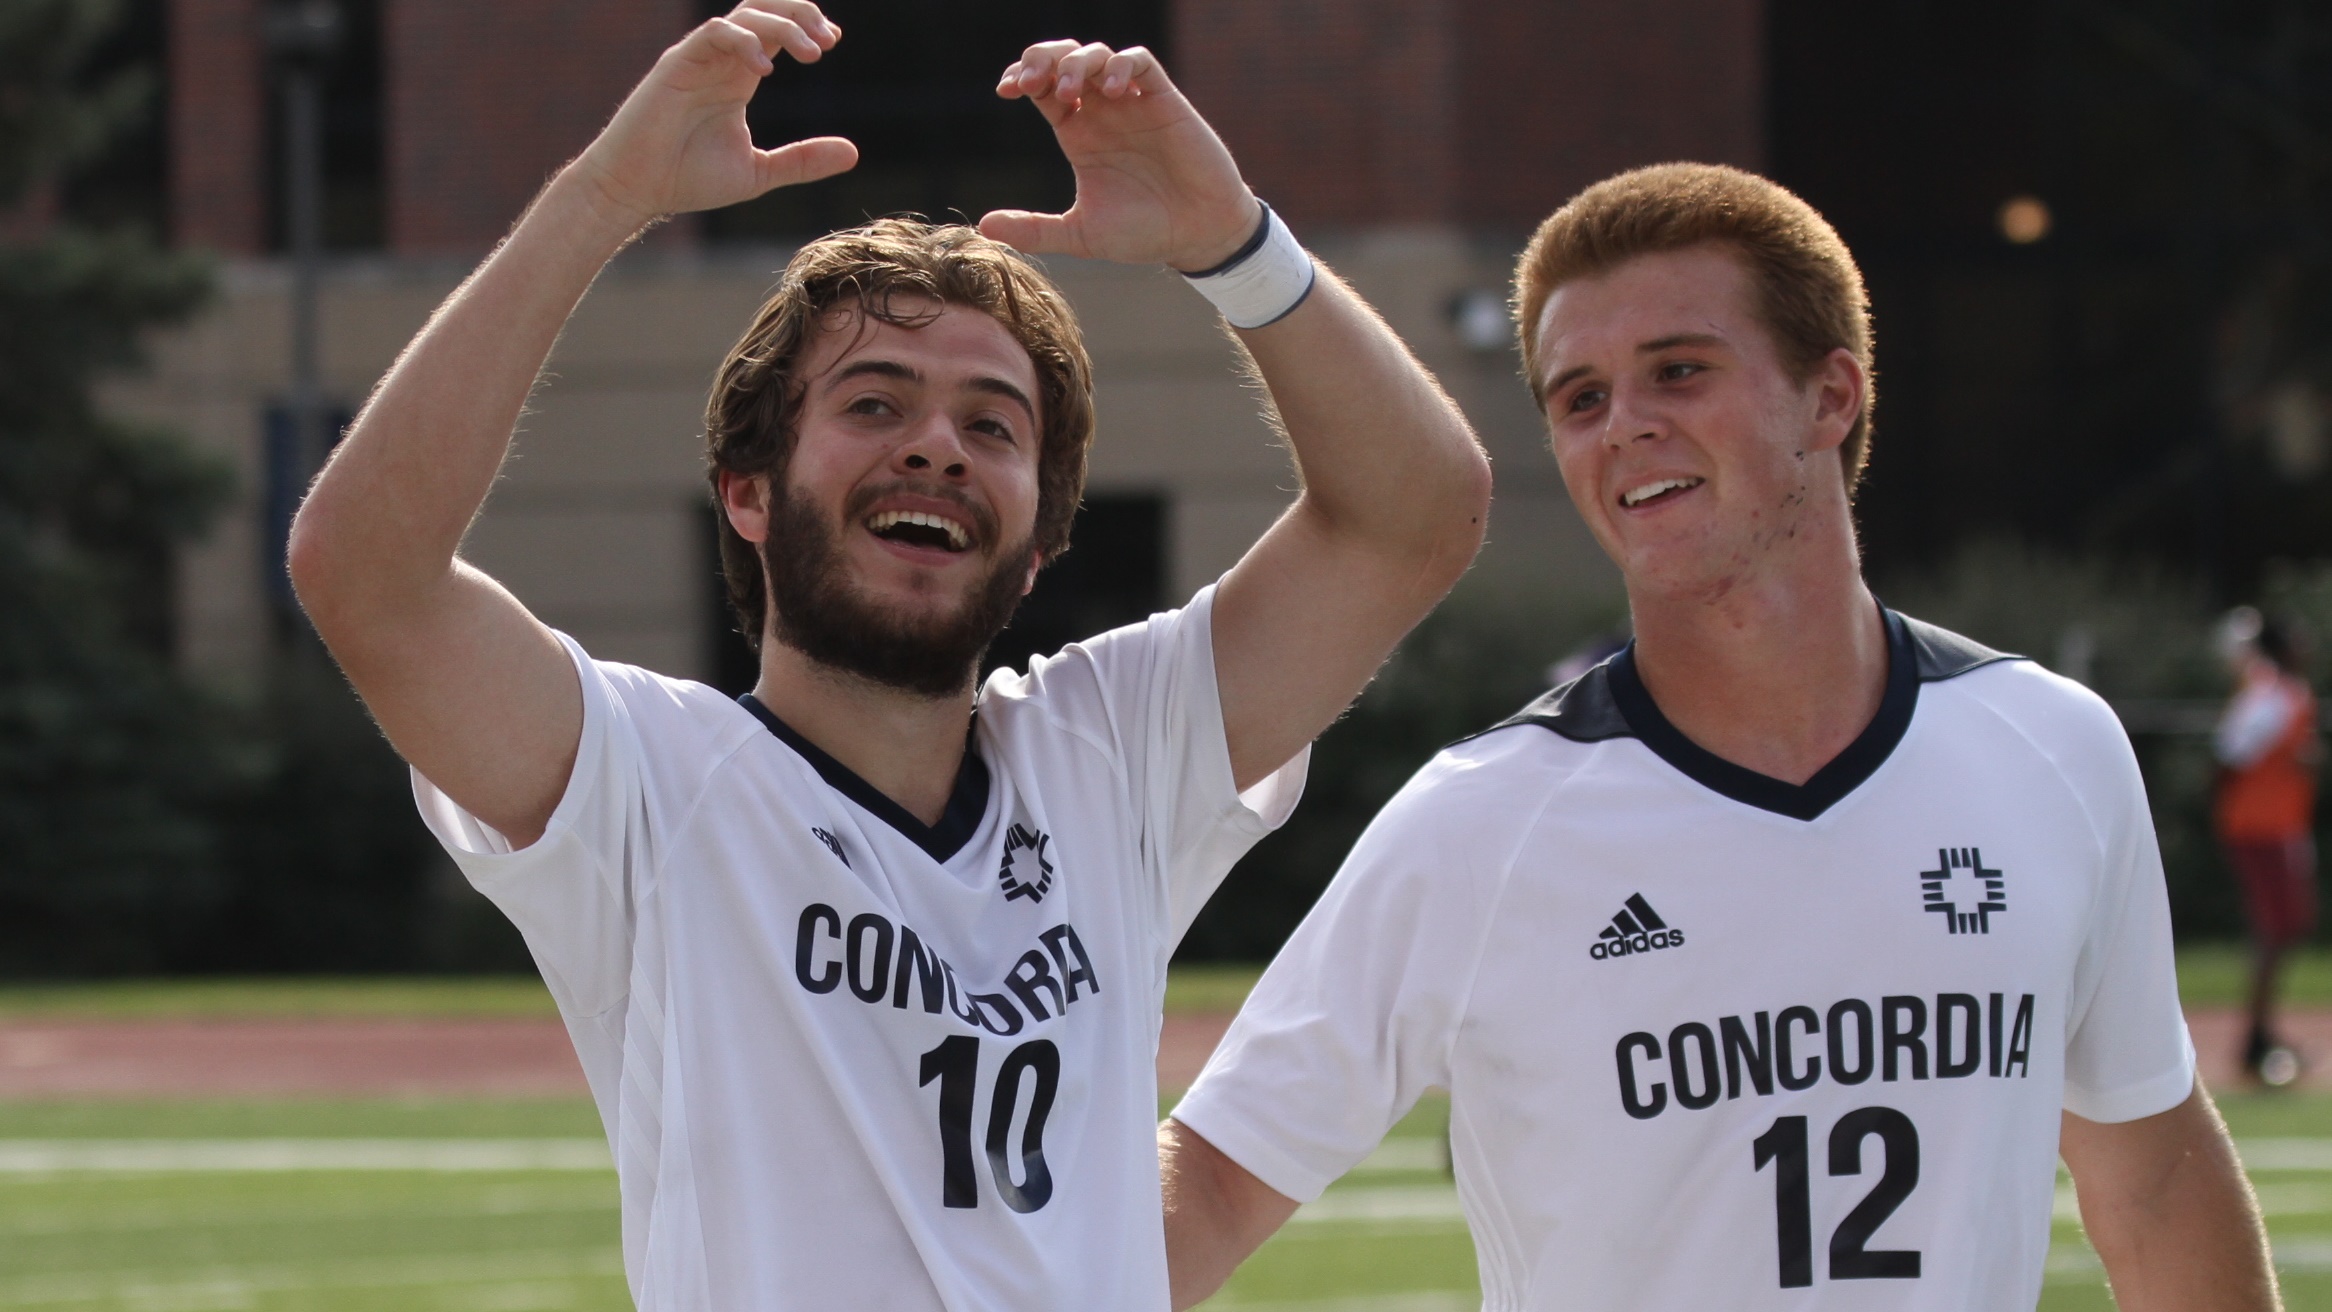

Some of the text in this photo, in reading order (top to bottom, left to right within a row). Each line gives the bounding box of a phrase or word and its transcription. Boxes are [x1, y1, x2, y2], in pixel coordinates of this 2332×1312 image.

[795, 902, 1101, 1037] CONCORDA
[1589, 929, 1685, 961] adidas
[918, 1034, 1061, 1214] 10
[1615, 992, 2036, 1121] CONCORDIA
[1753, 1106, 1922, 1289] 12
